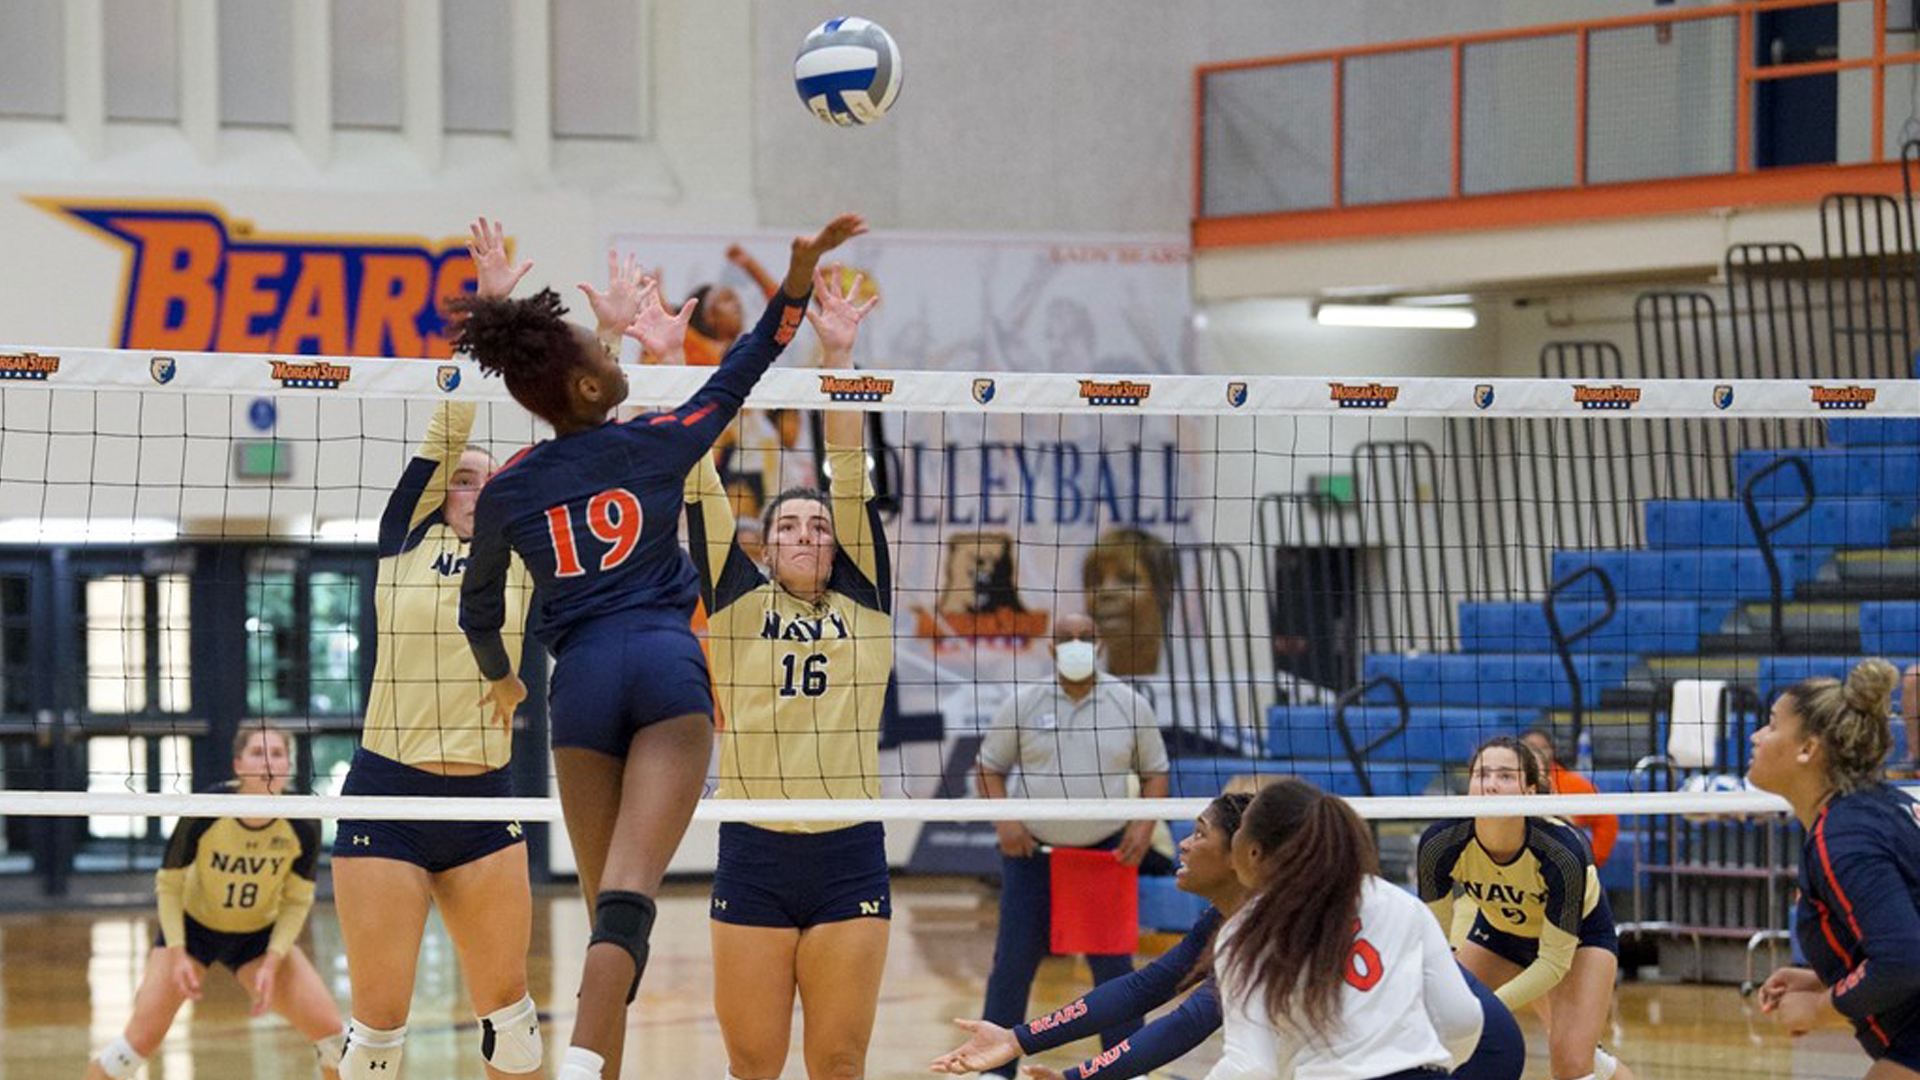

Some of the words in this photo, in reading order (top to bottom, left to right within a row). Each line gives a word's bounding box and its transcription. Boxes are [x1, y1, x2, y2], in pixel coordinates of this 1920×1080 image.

[886, 441, 1192, 526] LLEYBALL
[545, 488, 643, 578] 19
[761, 611, 847, 642] NAVY
[780, 653, 828, 697] 16
[211, 851, 284, 876] NAVY
[223, 882, 259, 909] 18
[1463, 881, 1549, 905] NAVY
[1029, 998, 1088, 1035] BEARS
[1079, 1038, 1131, 1079] LADY
